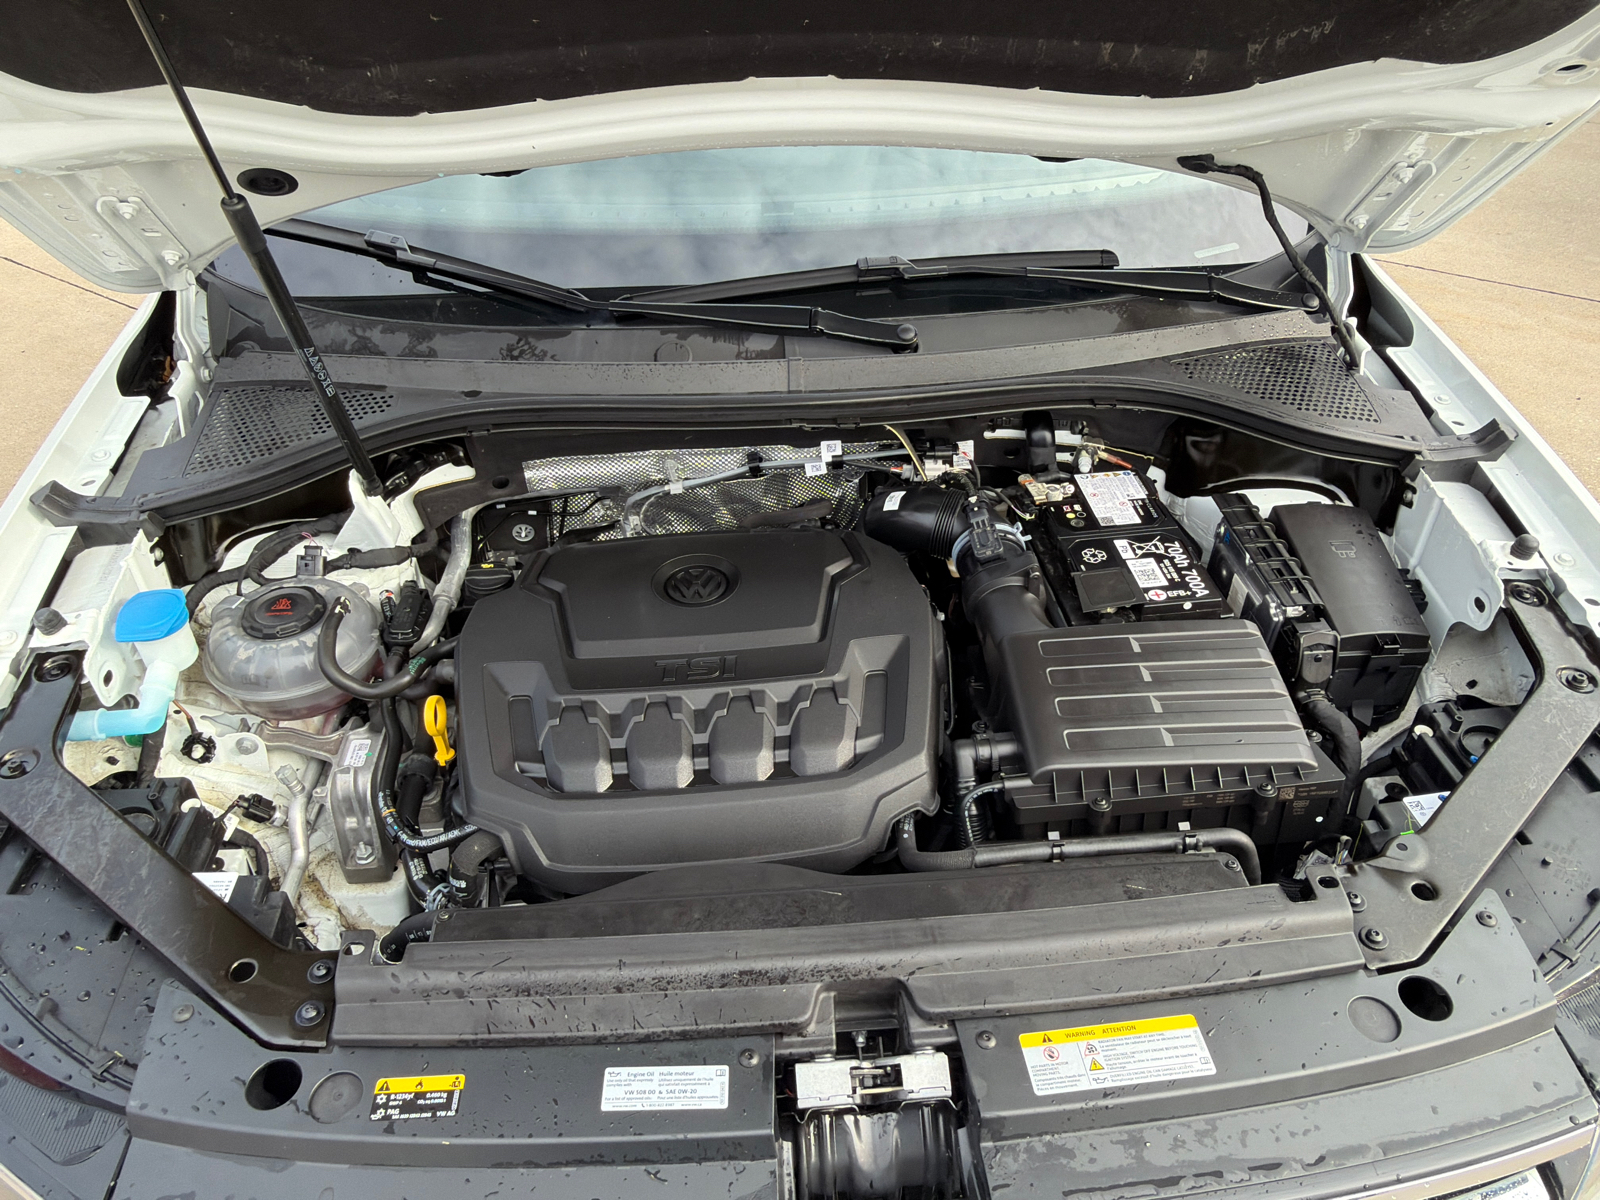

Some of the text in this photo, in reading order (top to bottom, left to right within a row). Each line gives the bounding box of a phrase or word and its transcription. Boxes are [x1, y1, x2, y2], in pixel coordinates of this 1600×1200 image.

[1164, 541, 1190, 567] 70Ah
[1181, 569, 1210, 598] 700A
[655, 655, 738, 681] TSI
[1064, 1025, 1137, 1039] WARNING ATTENTION
